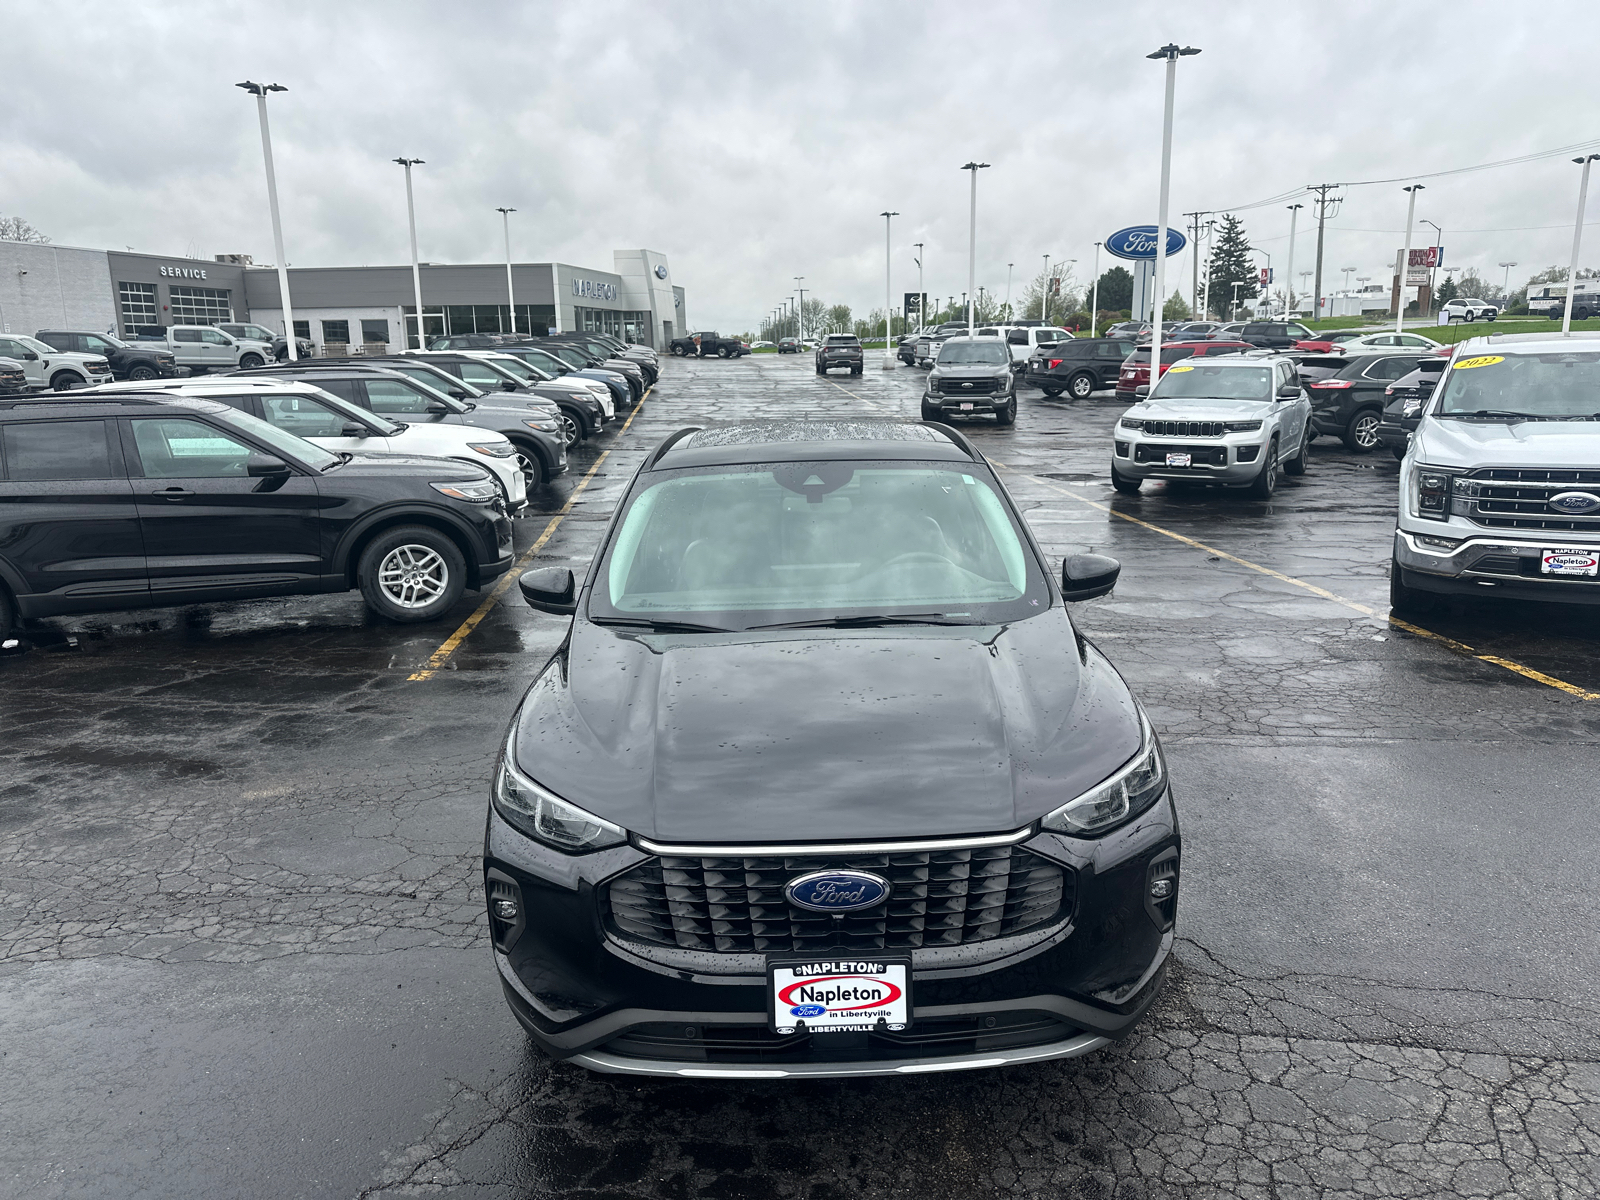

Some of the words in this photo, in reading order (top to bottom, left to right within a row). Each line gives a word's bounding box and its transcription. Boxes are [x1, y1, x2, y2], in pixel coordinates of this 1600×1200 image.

[160, 266, 207, 280] SERVICE
[572, 278, 617, 301] NAPLETON
[1460, 357, 1496, 368] 2022
[1563, 497, 1589, 507] Ford
[1553, 557, 1588, 565] Napleton
[810, 881, 866, 904] Ford
[801, 962, 878, 975] NAPLETON
[800, 985, 882, 1005] Napleton
[797, 1007, 820, 1016] Ford
[840, 1010, 892, 1018] Libertyville
